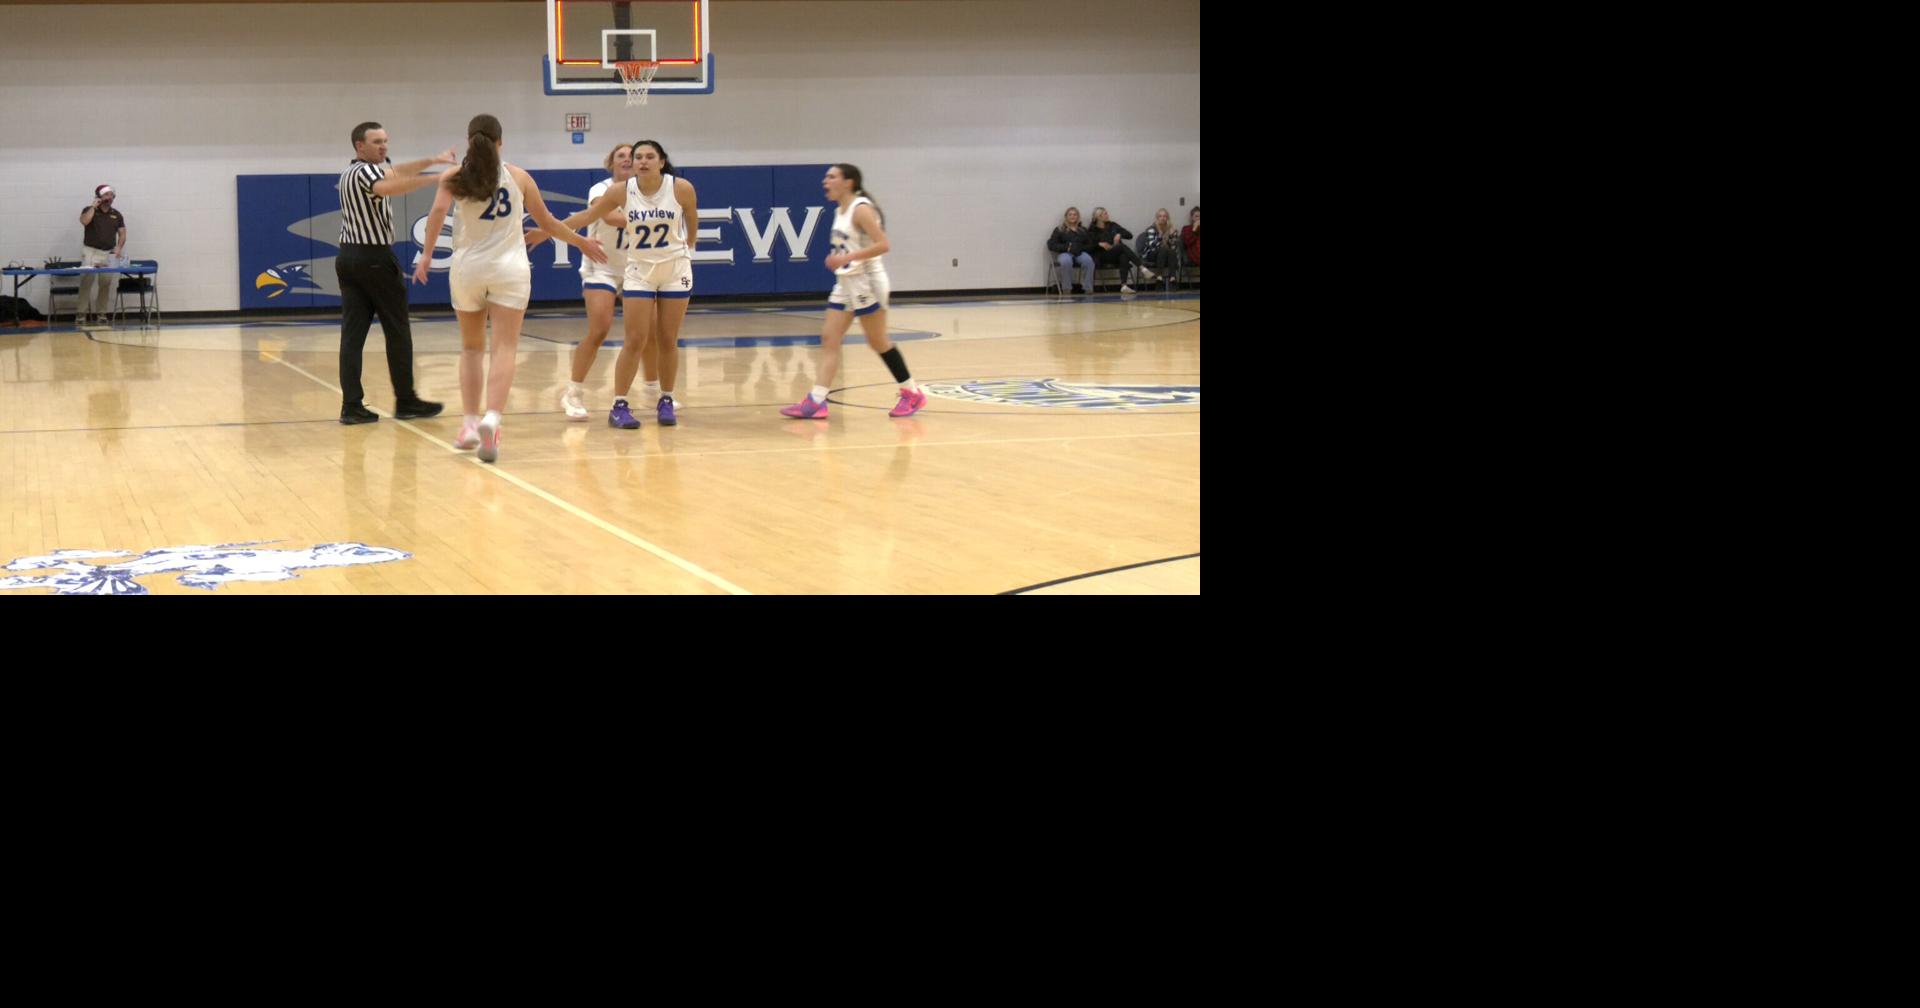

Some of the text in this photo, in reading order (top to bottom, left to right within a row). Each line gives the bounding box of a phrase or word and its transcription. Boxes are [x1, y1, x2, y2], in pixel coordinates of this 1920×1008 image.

[571, 116, 586, 128] EXIT
[479, 187, 512, 220] 23
[628, 207, 675, 222] Skyview
[616, 227, 630, 249] 1
[635, 223, 670, 249] 22
